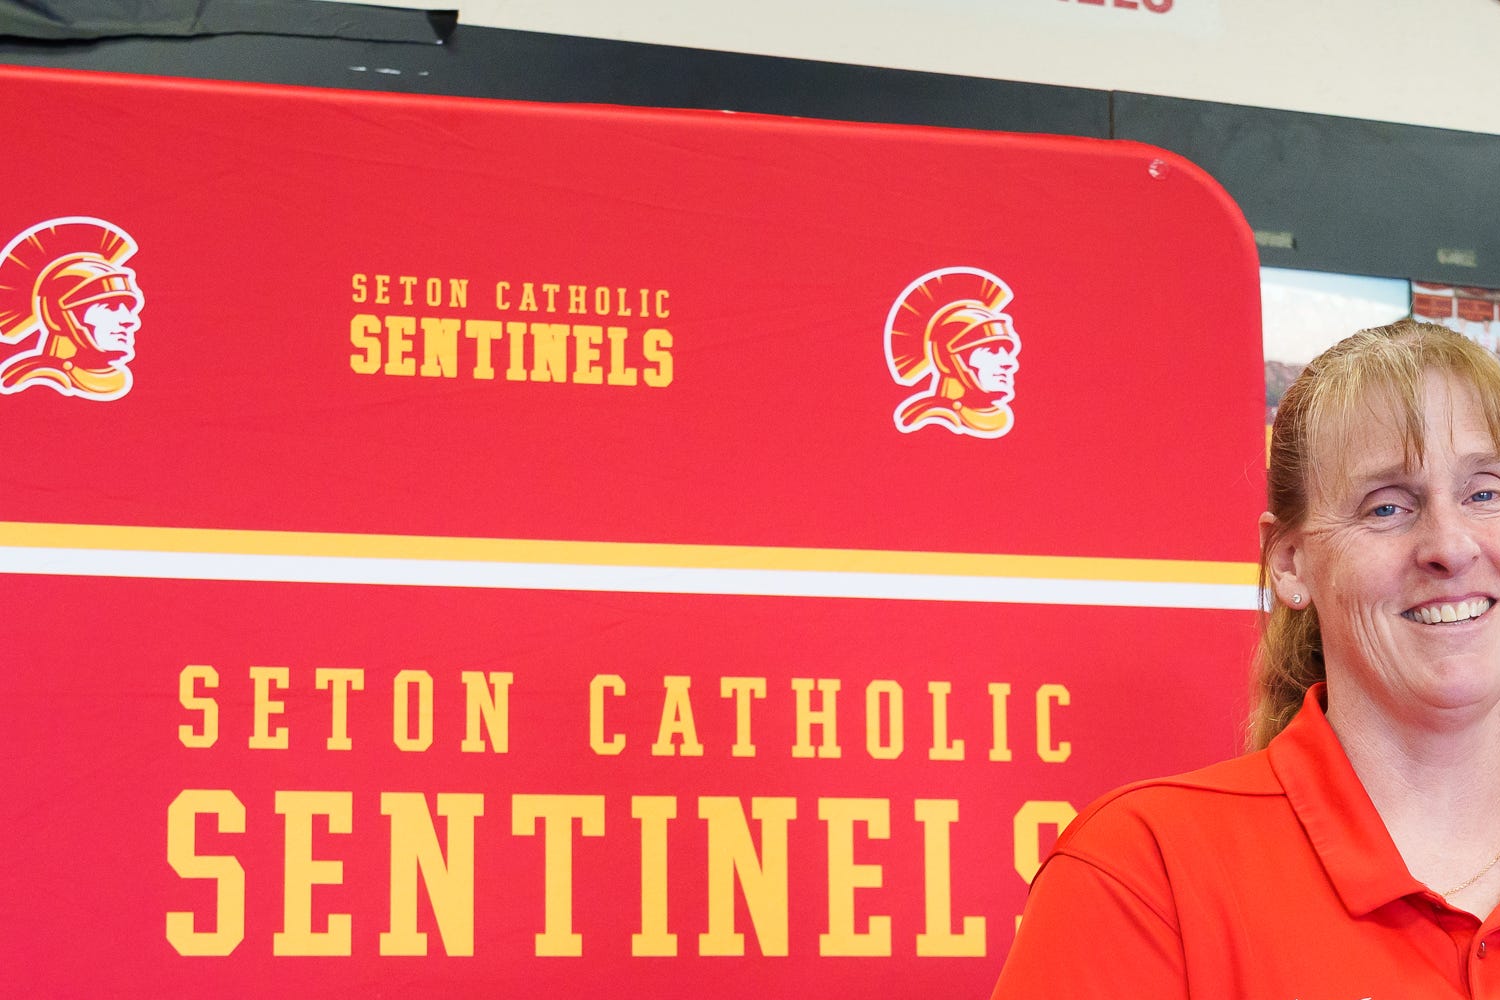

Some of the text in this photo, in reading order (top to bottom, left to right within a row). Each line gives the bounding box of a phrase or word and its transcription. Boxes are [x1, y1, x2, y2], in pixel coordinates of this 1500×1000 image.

[351, 273, 671, 319] SETON CATHOLIC
[349, 313, 674, 388] SENTINELS
[177, 664, 1073, 763] SETON CATHOLIC
